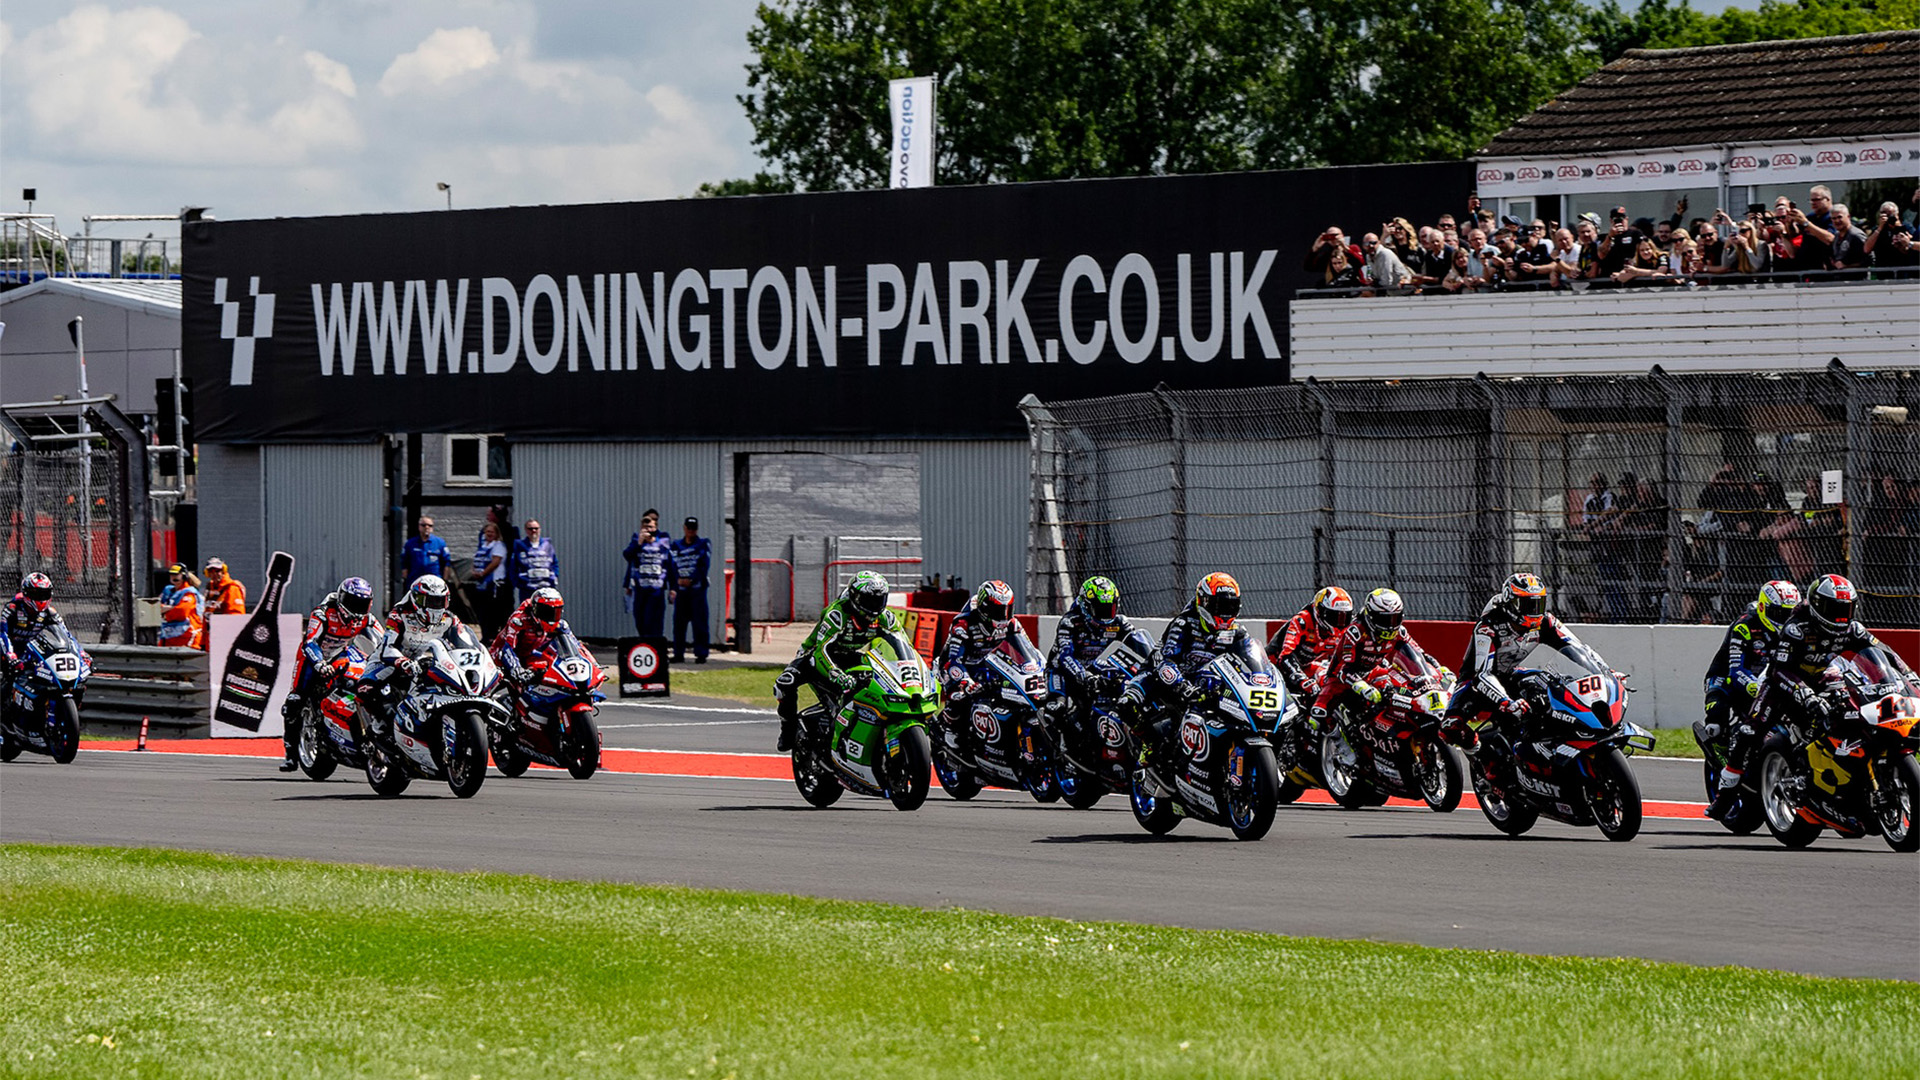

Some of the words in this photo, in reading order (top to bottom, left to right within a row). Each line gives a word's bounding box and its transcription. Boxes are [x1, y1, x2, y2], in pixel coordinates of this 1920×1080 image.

[311, 250, 1281, 376] WWW.DONINGTON-PARK.CO.UK
[55, 657, 77, 672] 28
[460, 652, 481, 666] 31
[633, 654, 654, 668] 60
[566, 663, 586, 675] 97
[901, 666, 920, 682] 22
[1576, 676, 1603, 695] 60
[1249, 690, 1278, 708] 55
